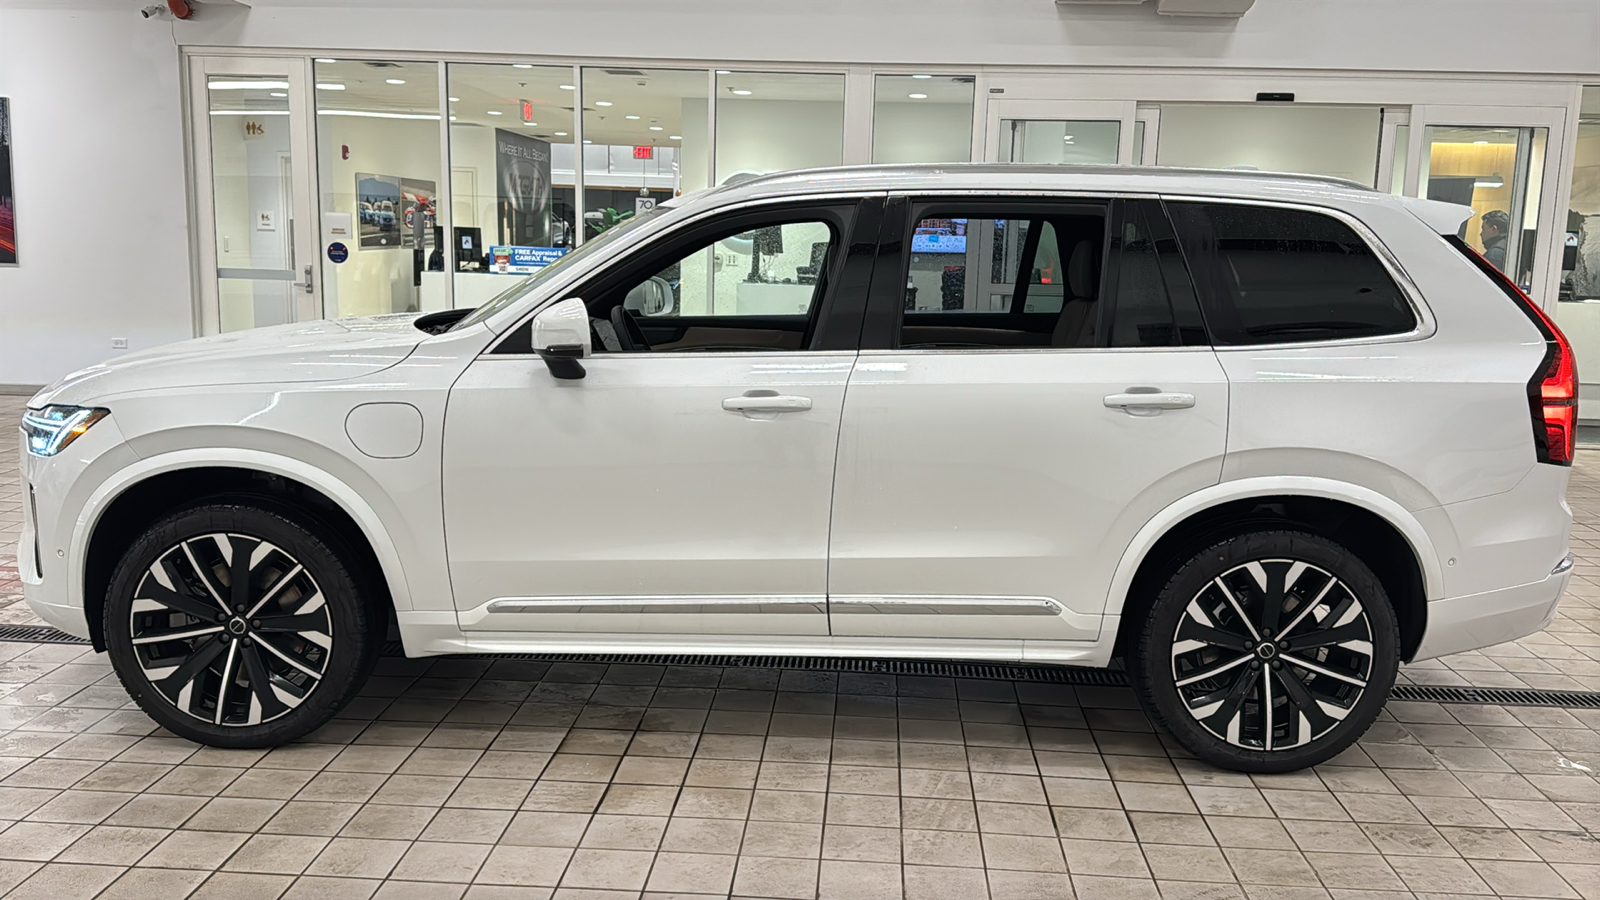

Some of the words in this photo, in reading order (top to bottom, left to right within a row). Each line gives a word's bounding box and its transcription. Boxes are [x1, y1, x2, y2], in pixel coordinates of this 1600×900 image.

[498, 141, 518, 157] WHERE
[523, 147, 532, 159] ALL
[636, 146, 651, 158] EXIT
[638, 200, 653, 210] 70
[532, 249, 557, 257] Appraisal
